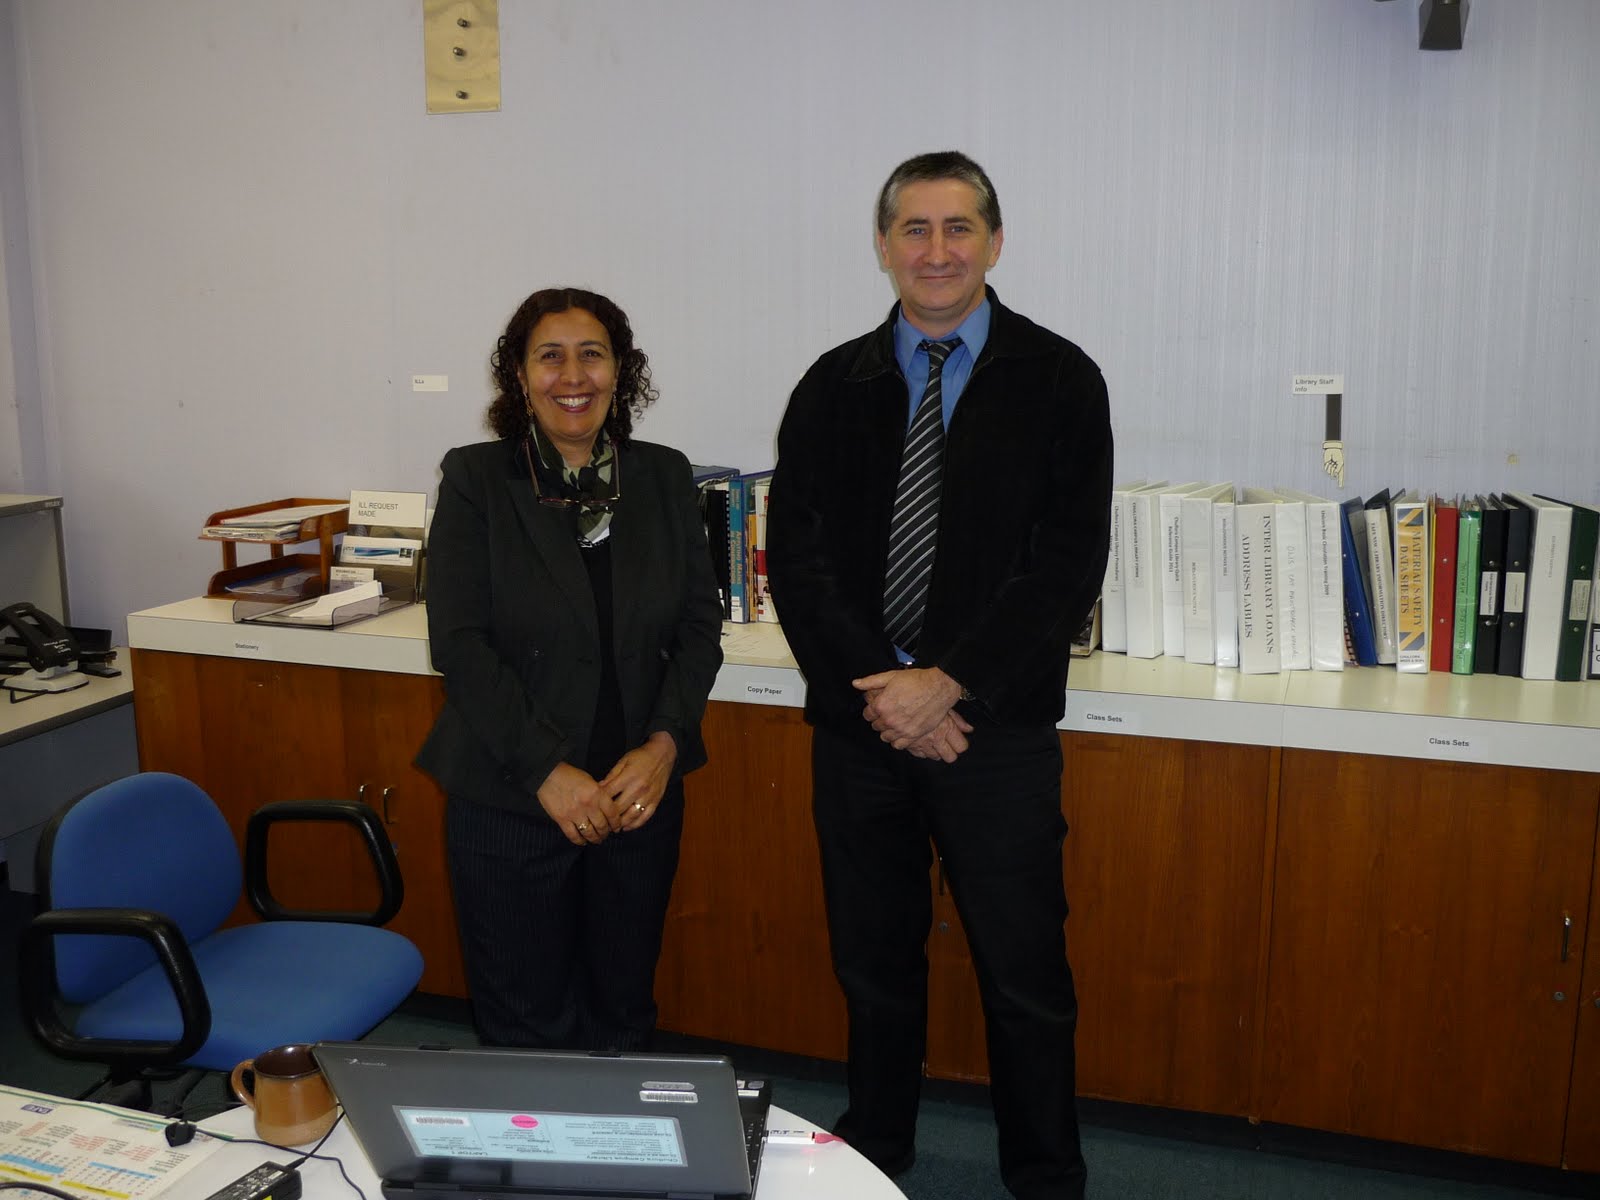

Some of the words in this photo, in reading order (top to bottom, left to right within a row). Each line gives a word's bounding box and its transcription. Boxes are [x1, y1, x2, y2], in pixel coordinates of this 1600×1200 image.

[358, 510, 377, 518] MADE
[368, 502, 399, 510] REQUEST
[1262, 514, 1272, 553] INTER
[1241, 534, 1251, 591] ADDRESS
[1400, 545, 1409, 572] DATA
[1412, 531, 1422, 583] MATERIAL
[1264, 556, 1274, 610] LIBRARY
[1376, 573, 1384, 610] INFORMATION
[1400, 573, 1409, 614] SHEETS
[1243, 593, 1253, 639] LABLES
[1412, 586, 1422, 627] SAFETY
[234, 642, 260, 650] Stationery
[1265, 613, 1275, 655] LOANS
[747, 685, 763, 695] Copy
[764, 687, 783, 696] Paper
[1086, 712, 1105, 721] Class
[1107, 714, 1123, 723] Sets
[1429, 737, 1451, 747] Class
[1453, 739, 1470, 748] Sets
